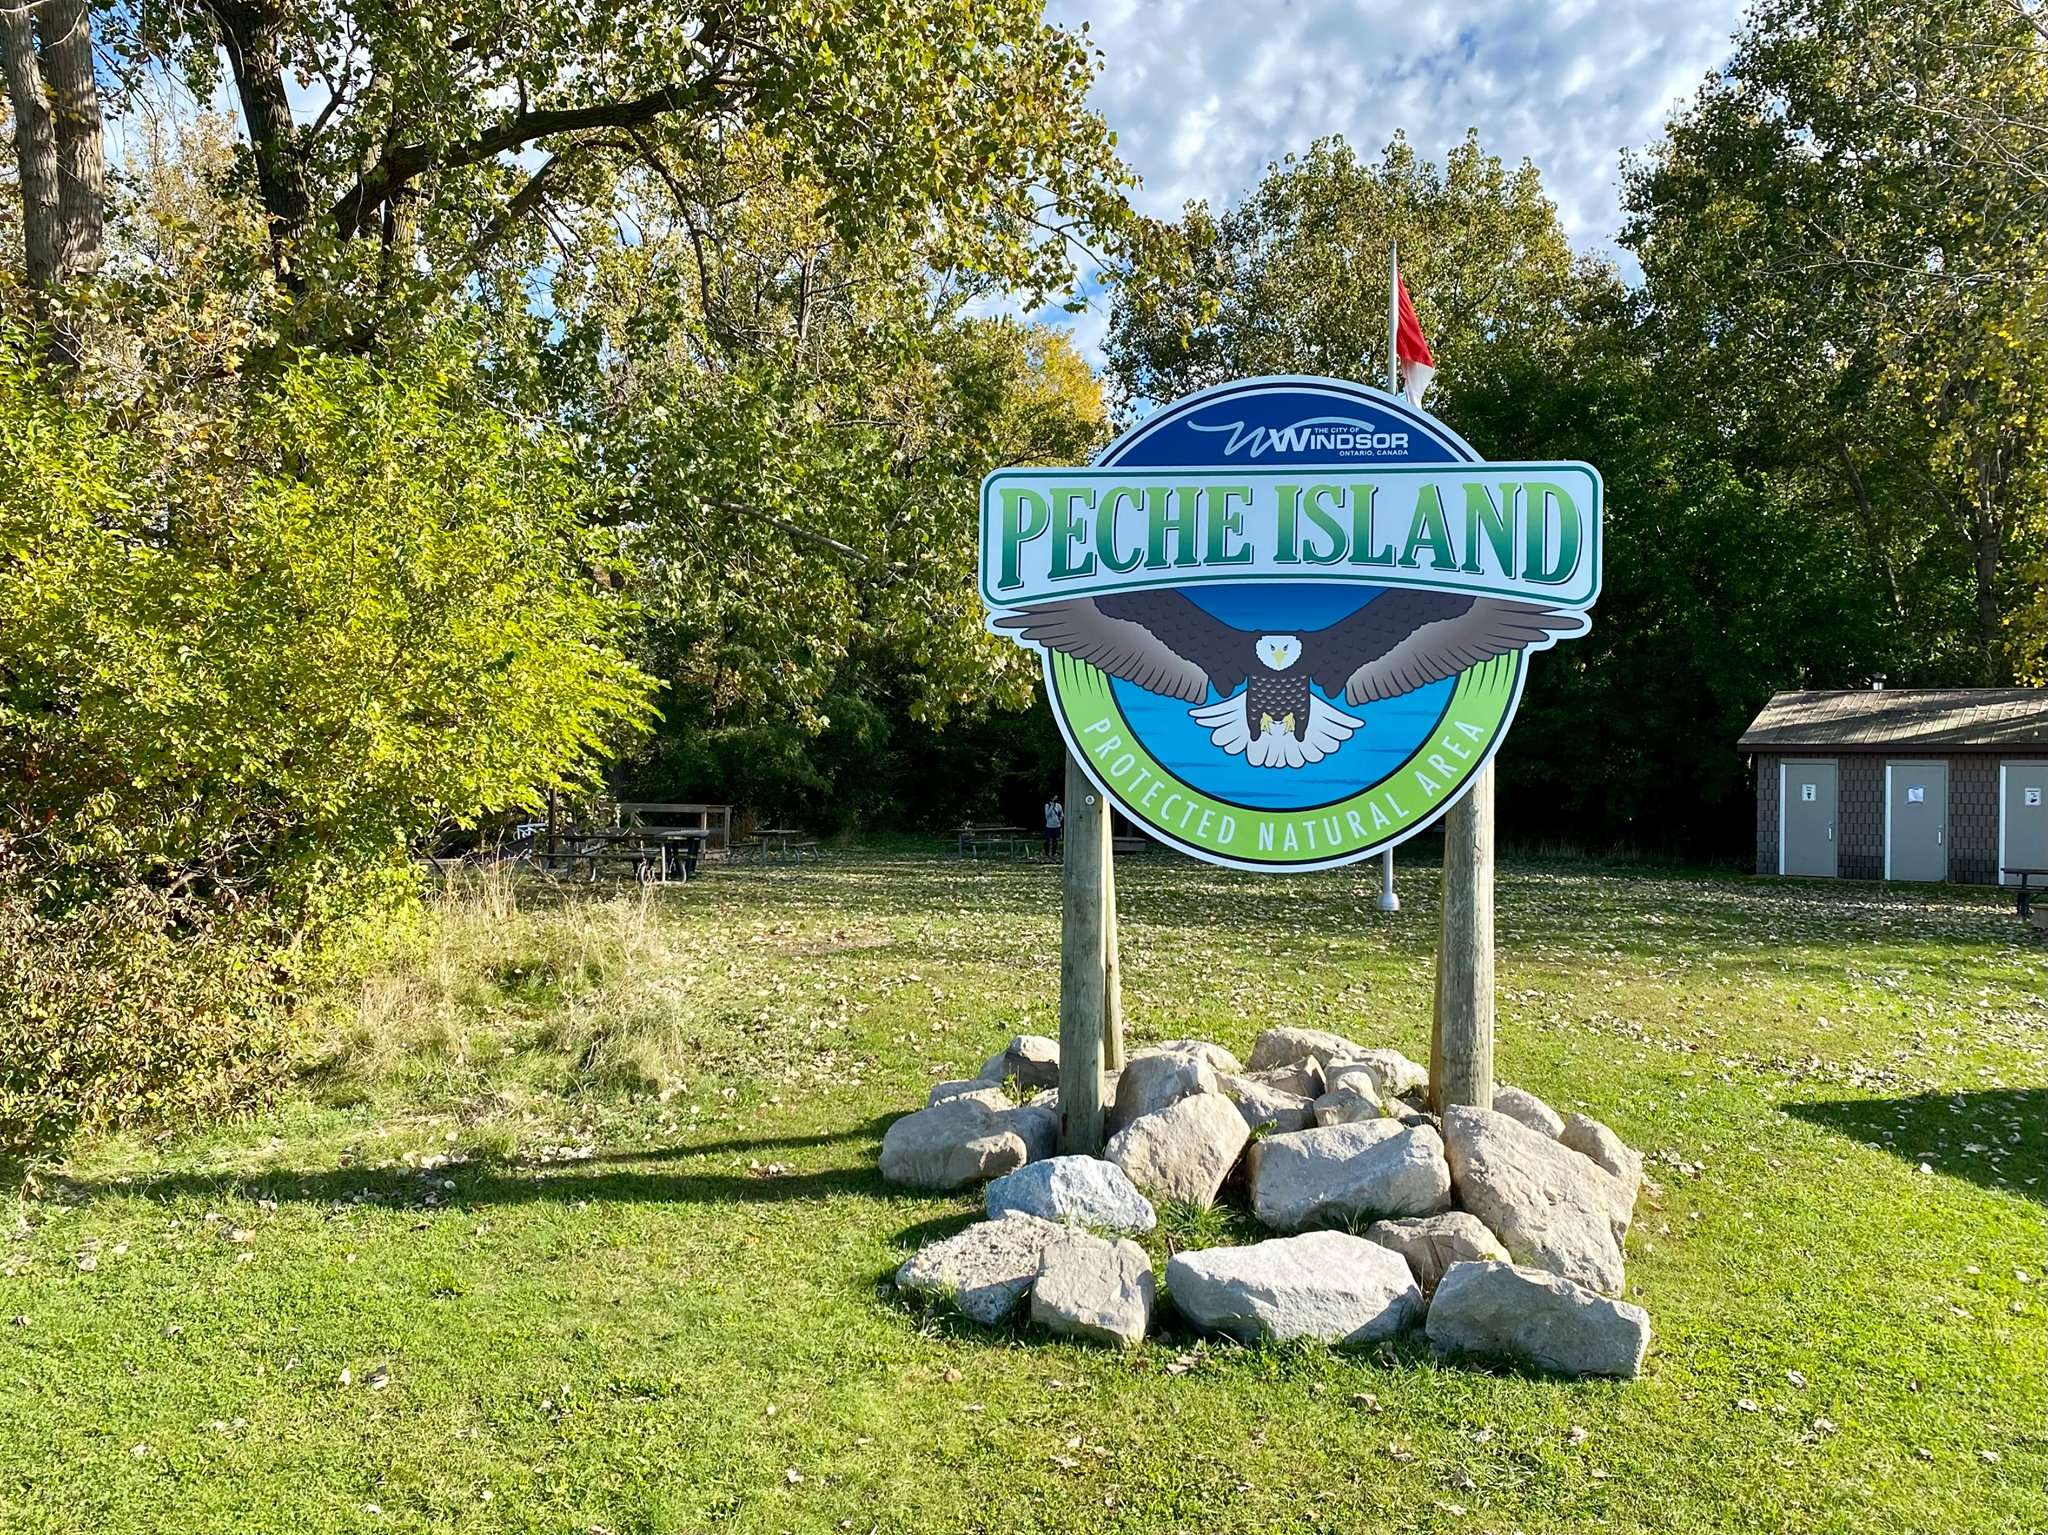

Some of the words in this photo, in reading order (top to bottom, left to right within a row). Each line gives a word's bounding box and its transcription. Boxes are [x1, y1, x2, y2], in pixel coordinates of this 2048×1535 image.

[1268, 428, 1409, 452] WINDSOR
[1339, 449, 1375, 457] ONTARIO,
[997, 486, 1254, 590] PECHE
[1272, 482, 1583, 584] ISLAND
[1083, 717, 1236, 845] PROTECTED
[1258, 792, 1409, 852] NATURAL
[1415, 719, 1485, 797] AREA
